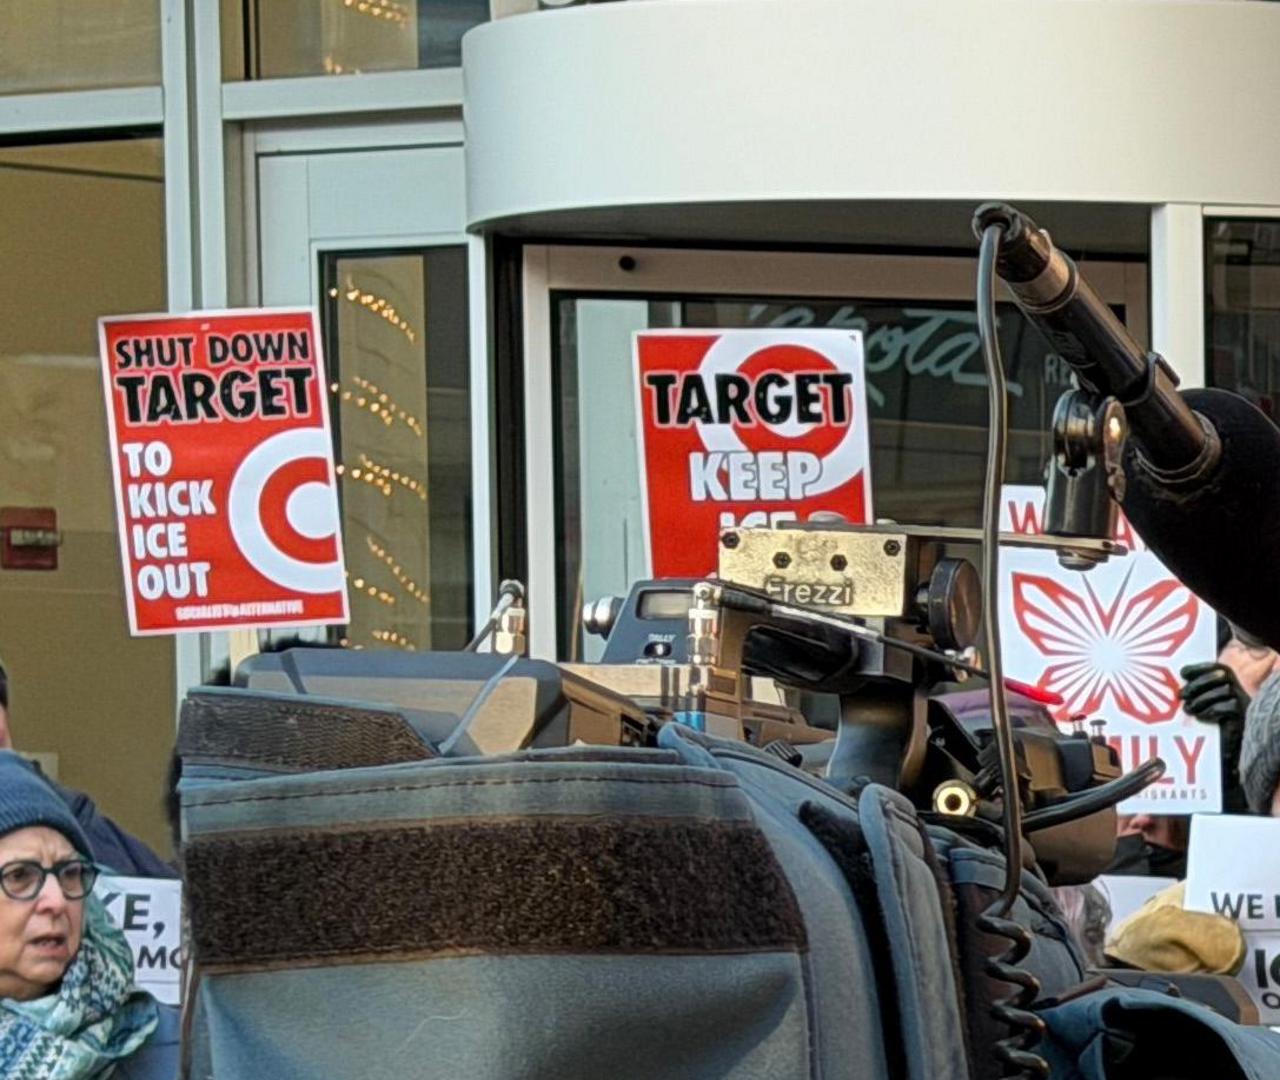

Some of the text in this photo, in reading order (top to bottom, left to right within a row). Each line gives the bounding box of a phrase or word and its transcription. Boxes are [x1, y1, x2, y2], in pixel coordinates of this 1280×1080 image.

[116, 331, 309, 369] SHUT DOWN
[116, 368, 312, 422] TARGET
[647, 373, 852, 425] TARGET
[122, 441, 172, 478] TO
[689, 452, 822, 501] KEEP
[128, 480, 216, 518] KICK
[133, 523, 188, 560] ICE
[137, 562, 210, 600] OUT
[1211, 892, 1264, 919] WE
